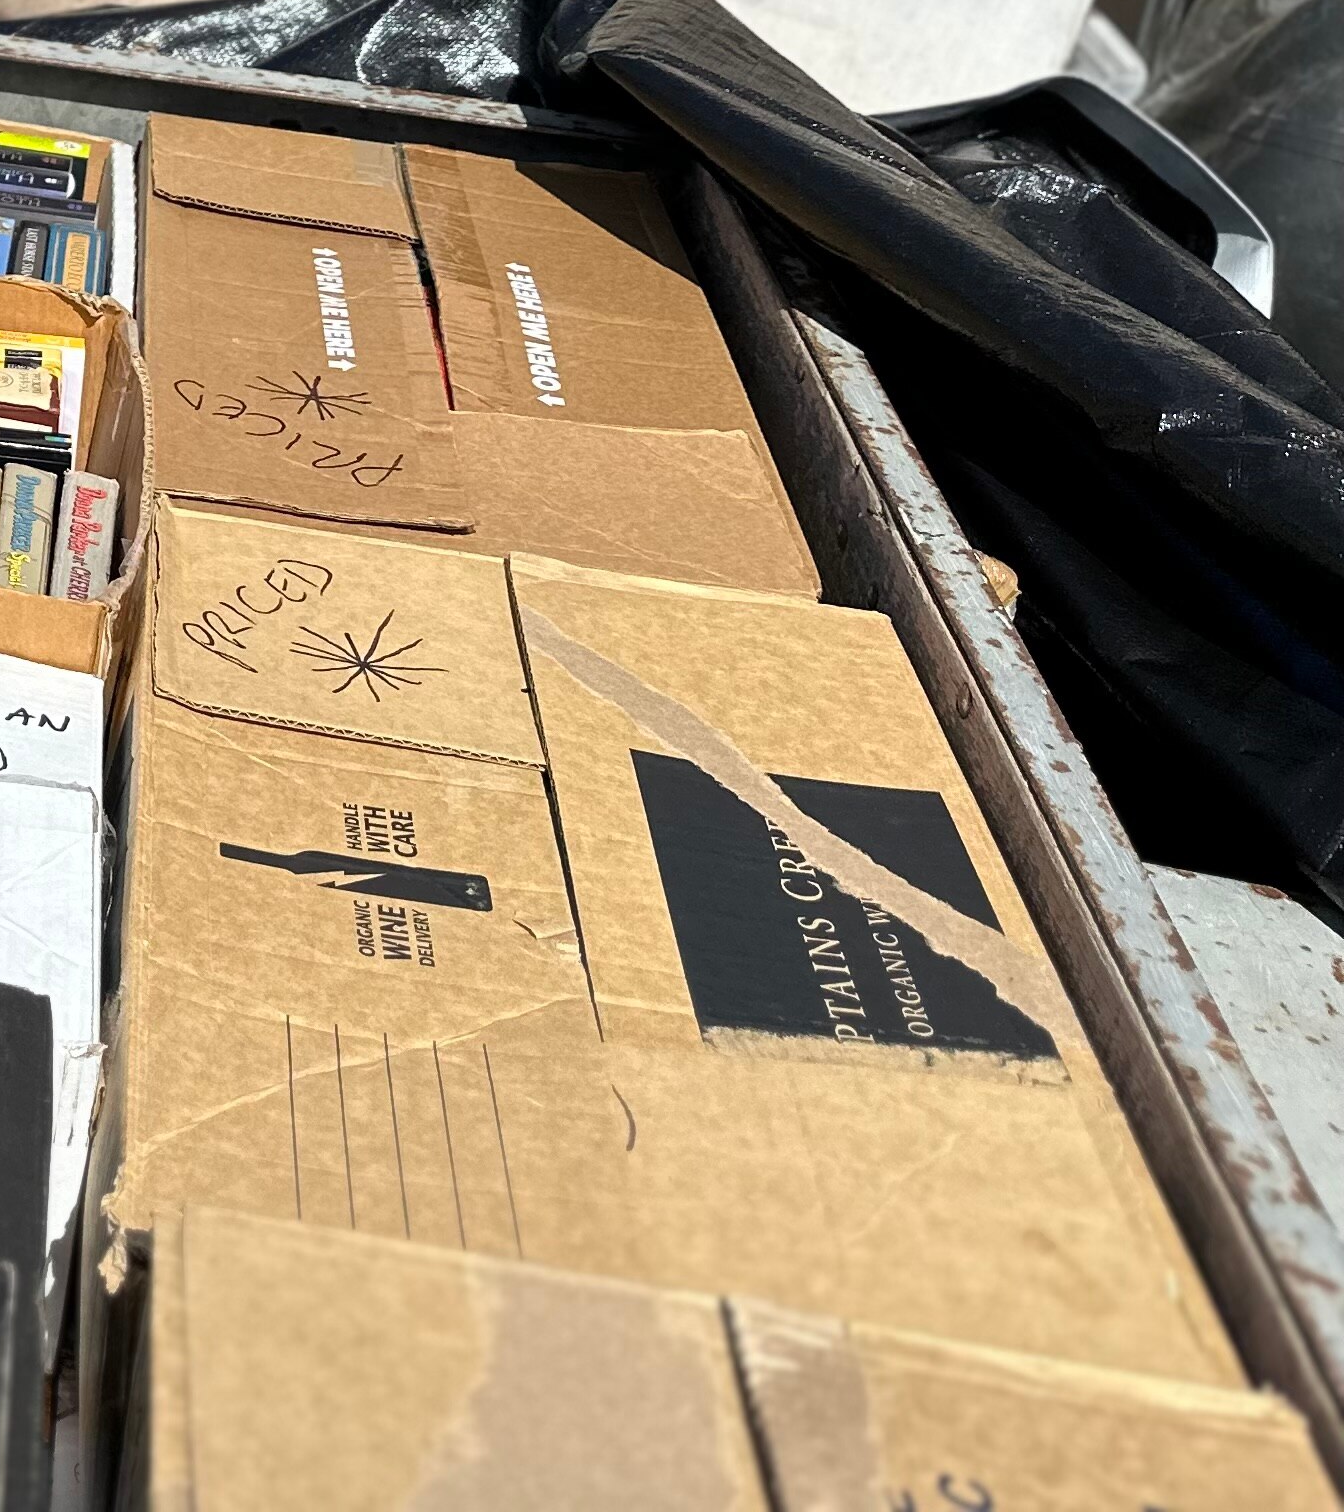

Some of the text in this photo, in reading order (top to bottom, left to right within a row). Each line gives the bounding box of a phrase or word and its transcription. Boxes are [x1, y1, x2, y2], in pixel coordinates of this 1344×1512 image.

[313, 258, 357, 358] OPEN ME HERE
[506, 271, 562, 391] OPEN ME HERE
[173, 378, 405, 488] PRICED
[182, 558, 333, 674] PRICED
[343, 802, 362, 850] HANDLE
[363, 805, 390, 853] WITH
[390, 810, 418, 858] CARE
[353, 900, 375, 957] ORGANIC
[378, 904, 412, 961] WINE
[412, 909, 435, 967] DELIVERY
[873, 932, 934, 1038] ORGANIC
